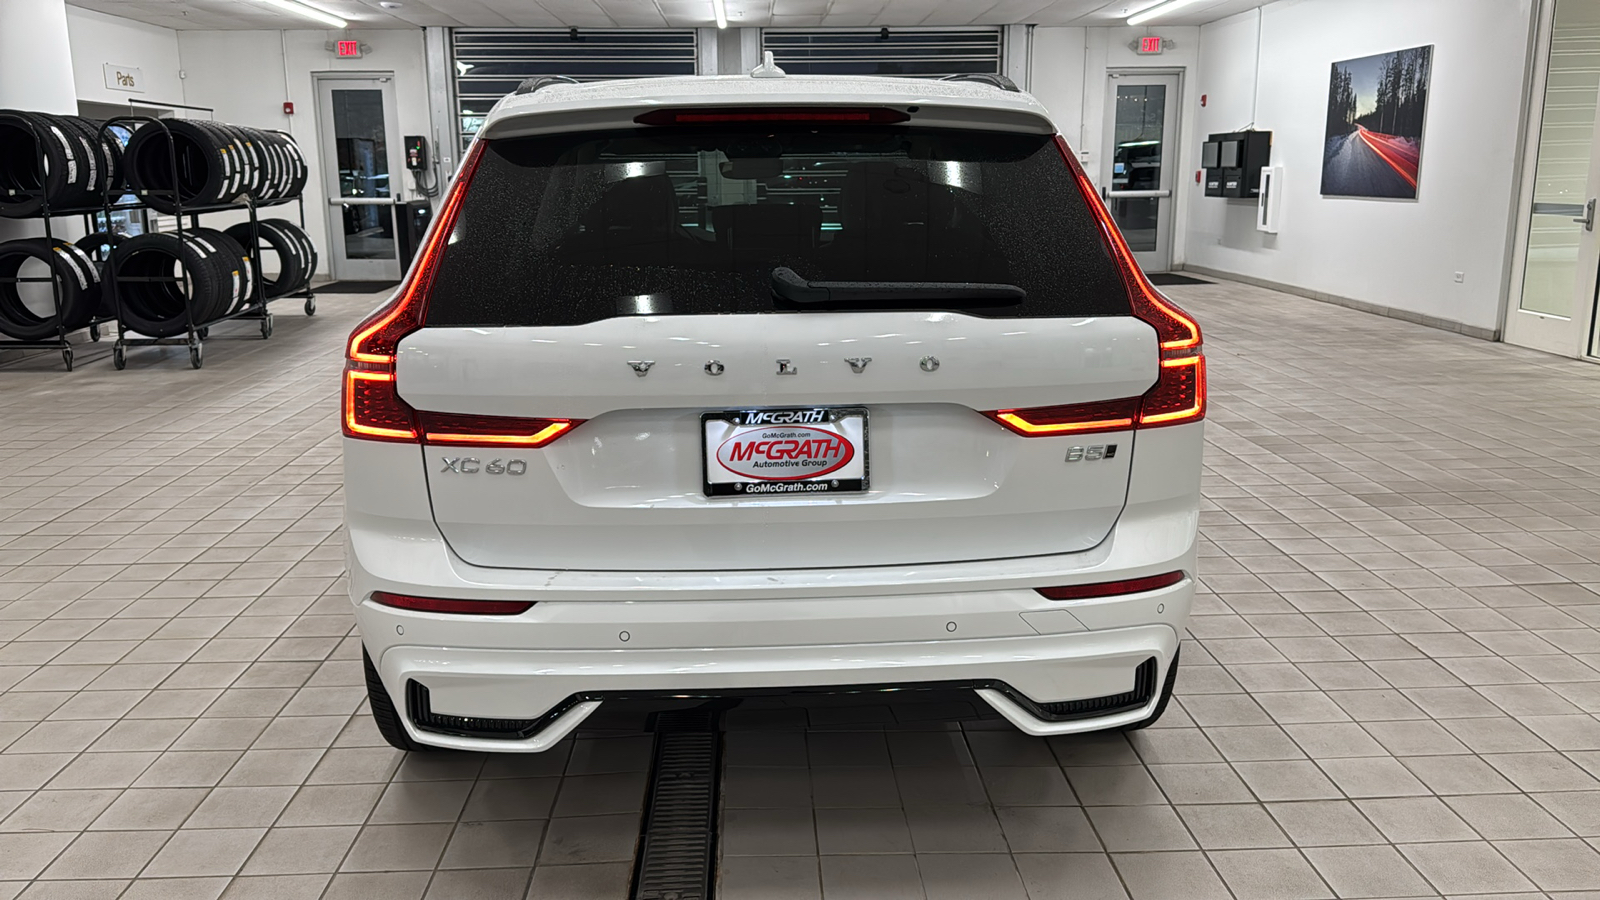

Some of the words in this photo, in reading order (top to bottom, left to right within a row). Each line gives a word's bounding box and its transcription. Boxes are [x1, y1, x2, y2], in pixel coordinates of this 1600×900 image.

[338, 41, 357, 55] EXIT
[1142, 37, 1160, 52] EXIT
[116, 71, 135, 87] Parts
[627, 355, 940, 377] VOLVO
[1065, 445, 1104, 463] B5
[753, 460, 800, 469] Automotive
[801, 459, 828, 468] Group
[746, 483, 828, 493] GoMcGrath.com
